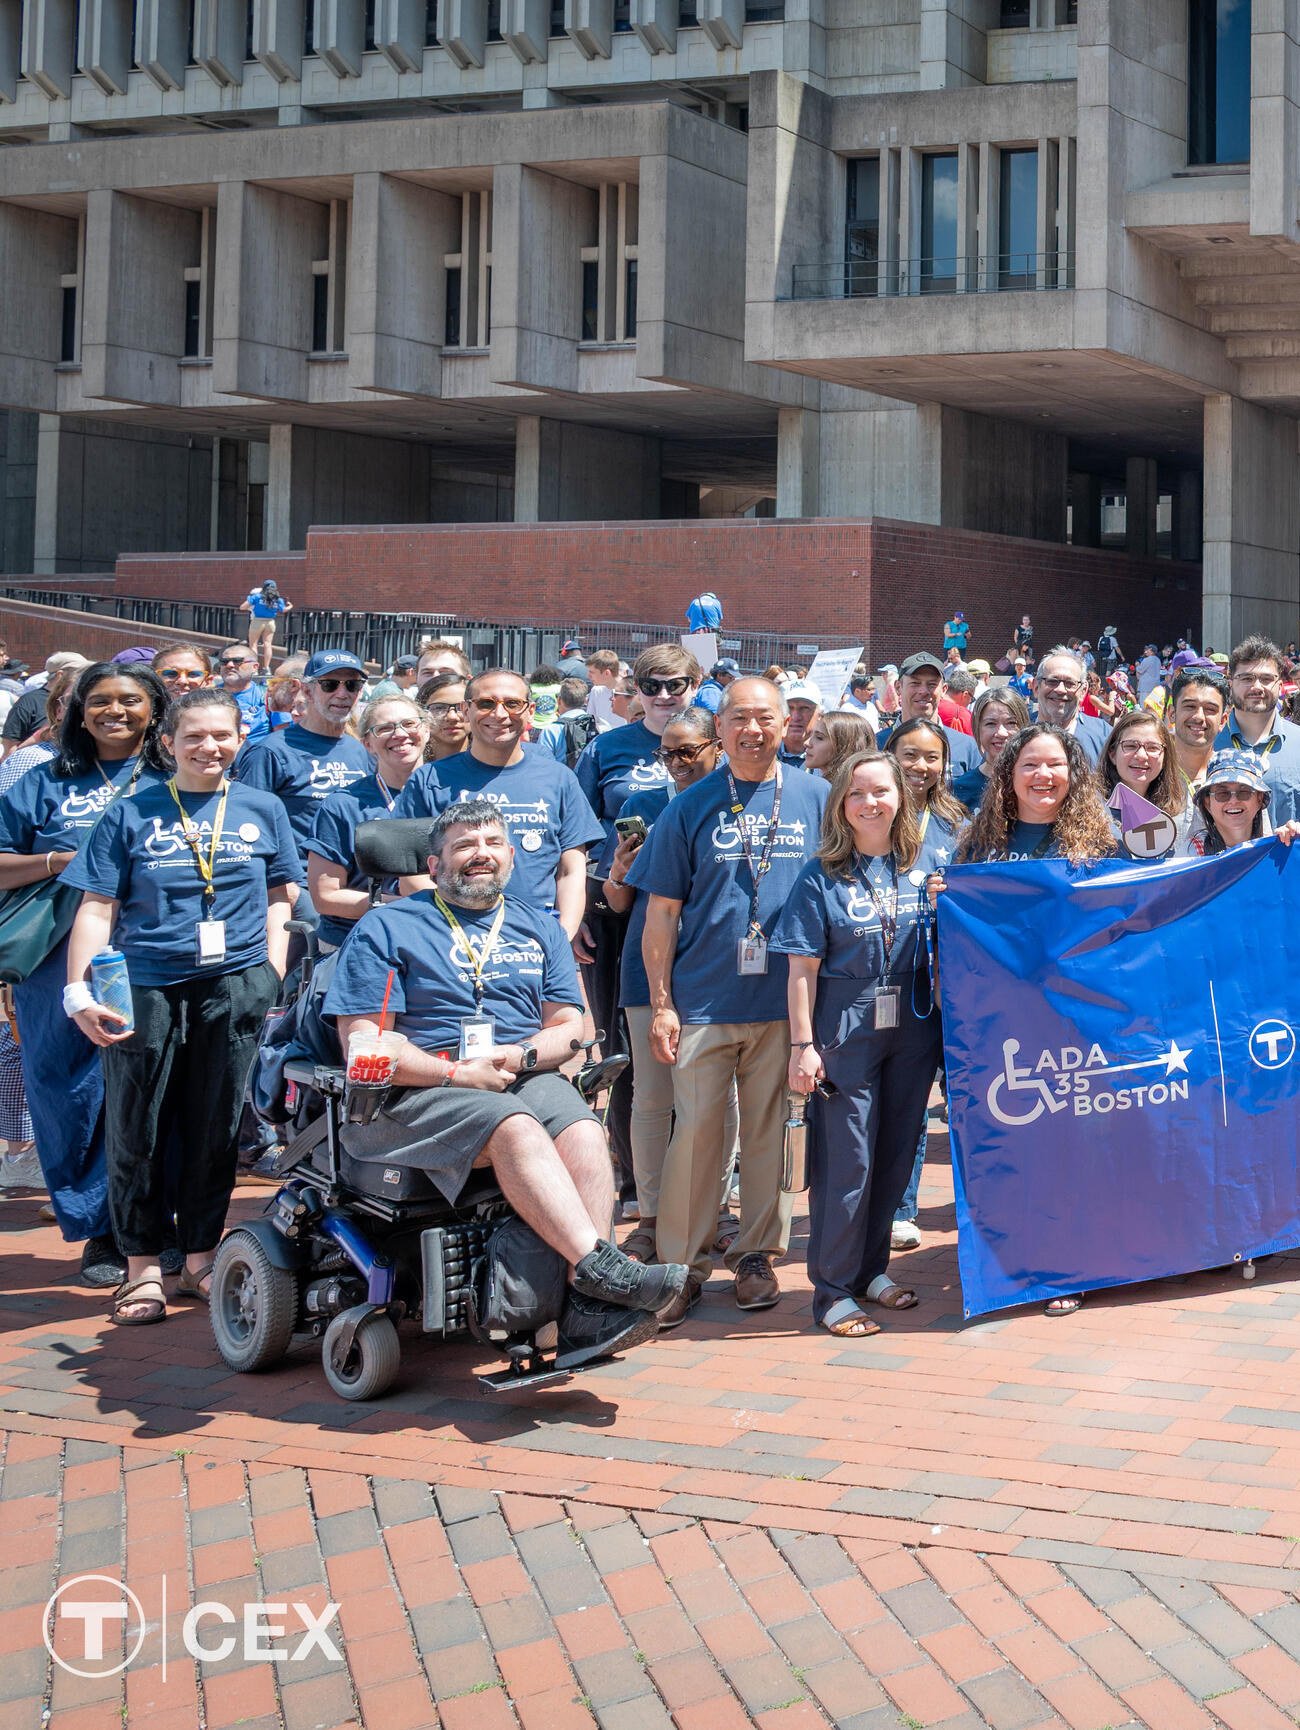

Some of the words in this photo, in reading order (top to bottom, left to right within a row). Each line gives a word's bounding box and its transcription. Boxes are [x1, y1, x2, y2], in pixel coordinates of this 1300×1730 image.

[326, 762, 348, 771] ADA
[476, 793, 510, 803] ADA
[504, 813, 548, 823] OSTON
[1132, 821, 1167, 850] T
[216, 855, 251, 864] massDO
[1034, 1043, 1109, 1073] ADA
[349, 1066, 392, 1083] GULP
[1054, 1072, 1090, 1095] 35
[1074, 1079, 1189, 1116] BOSTON
